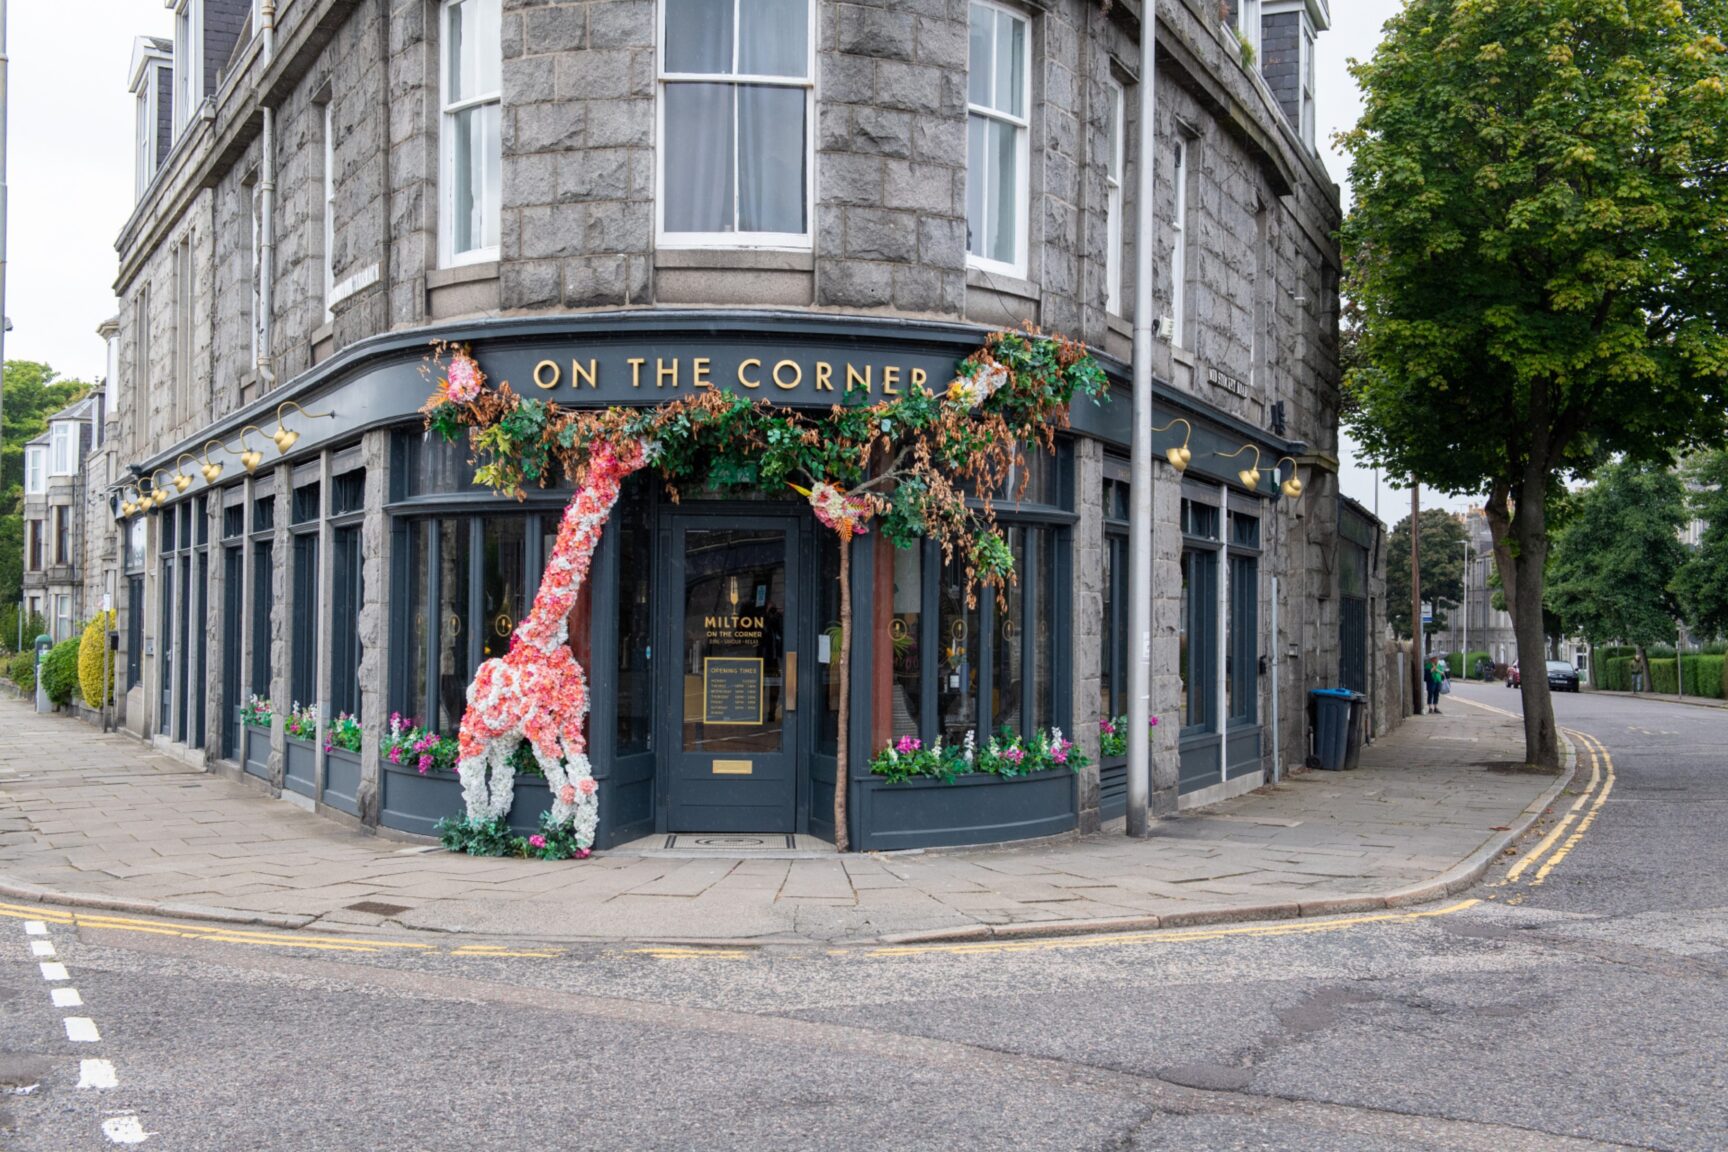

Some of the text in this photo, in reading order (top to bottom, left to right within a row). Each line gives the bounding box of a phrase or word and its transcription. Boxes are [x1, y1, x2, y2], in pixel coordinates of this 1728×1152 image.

[533, 358, 928, 396] ON THE CORNER
[704, 616, 764, 628] MILTON
